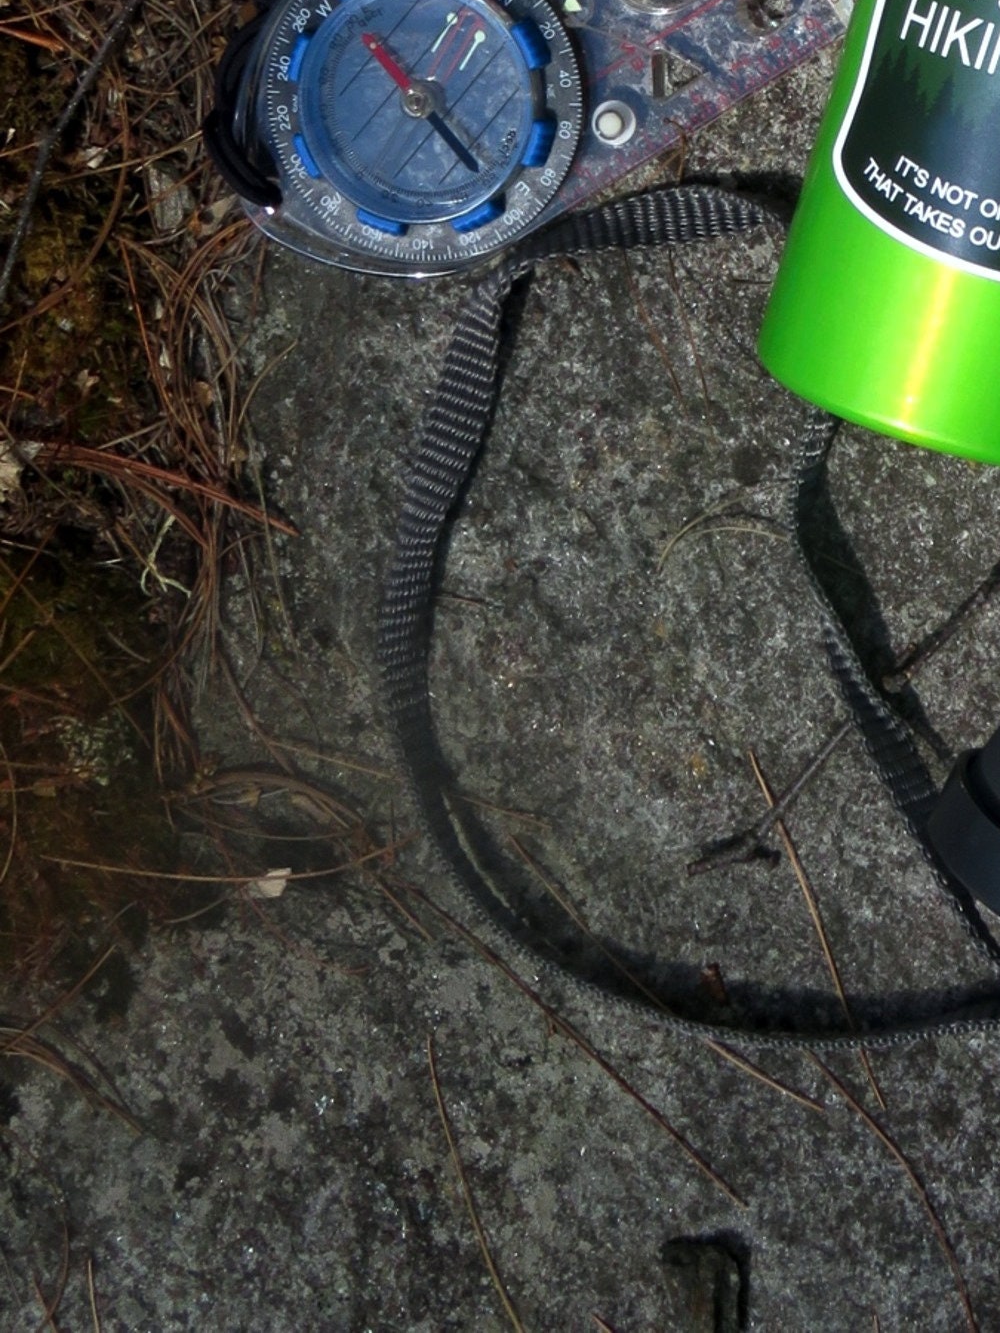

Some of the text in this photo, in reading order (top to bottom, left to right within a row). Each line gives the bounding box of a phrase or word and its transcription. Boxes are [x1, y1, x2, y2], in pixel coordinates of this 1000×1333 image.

[291, 7, 312, 34] 260
[539, 21, 556, 40] 20
[277, 55, 291, 82] 240
[559, 69, 573, 88] 40
[277, 105, 292, 131] 220
[558, 120, 573, 140] 60
[540, 168, 557, 187] 80
[895, 156, 930, 190] IT'S
[931, 177, 978, 211] NOT
[514, 181, 531, 196] E
[863, 157, 904, 203] THAT
[904, 193, 967, 246] TAKES
[503, 209, 525, 226] 100
[412, 238, 434, 251] 140
[458, 231, 482, 246] 120
